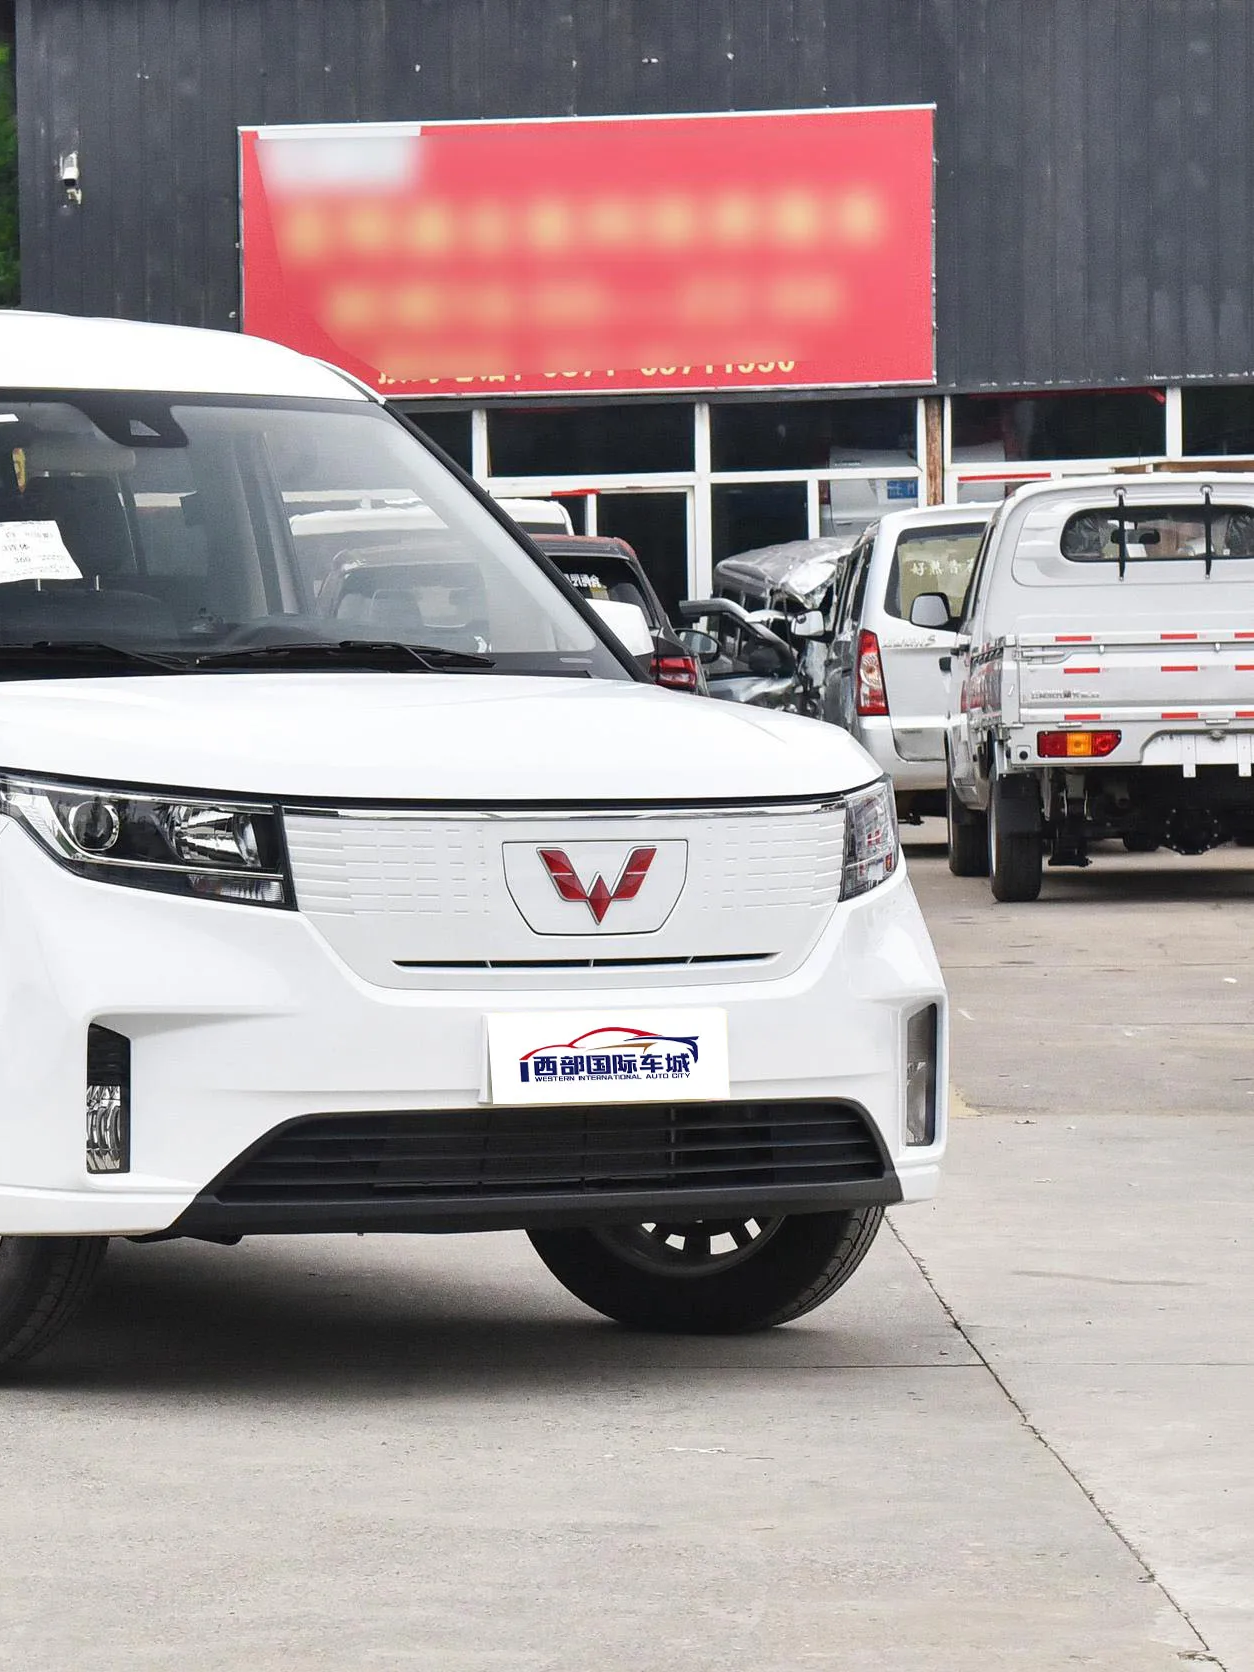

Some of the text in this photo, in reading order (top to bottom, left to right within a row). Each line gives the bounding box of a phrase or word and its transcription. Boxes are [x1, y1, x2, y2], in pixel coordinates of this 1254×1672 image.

[533, 1053, 691, 1076] 西部国际车城
[578, 1073, 642, 1081] INTERNATIONAL
